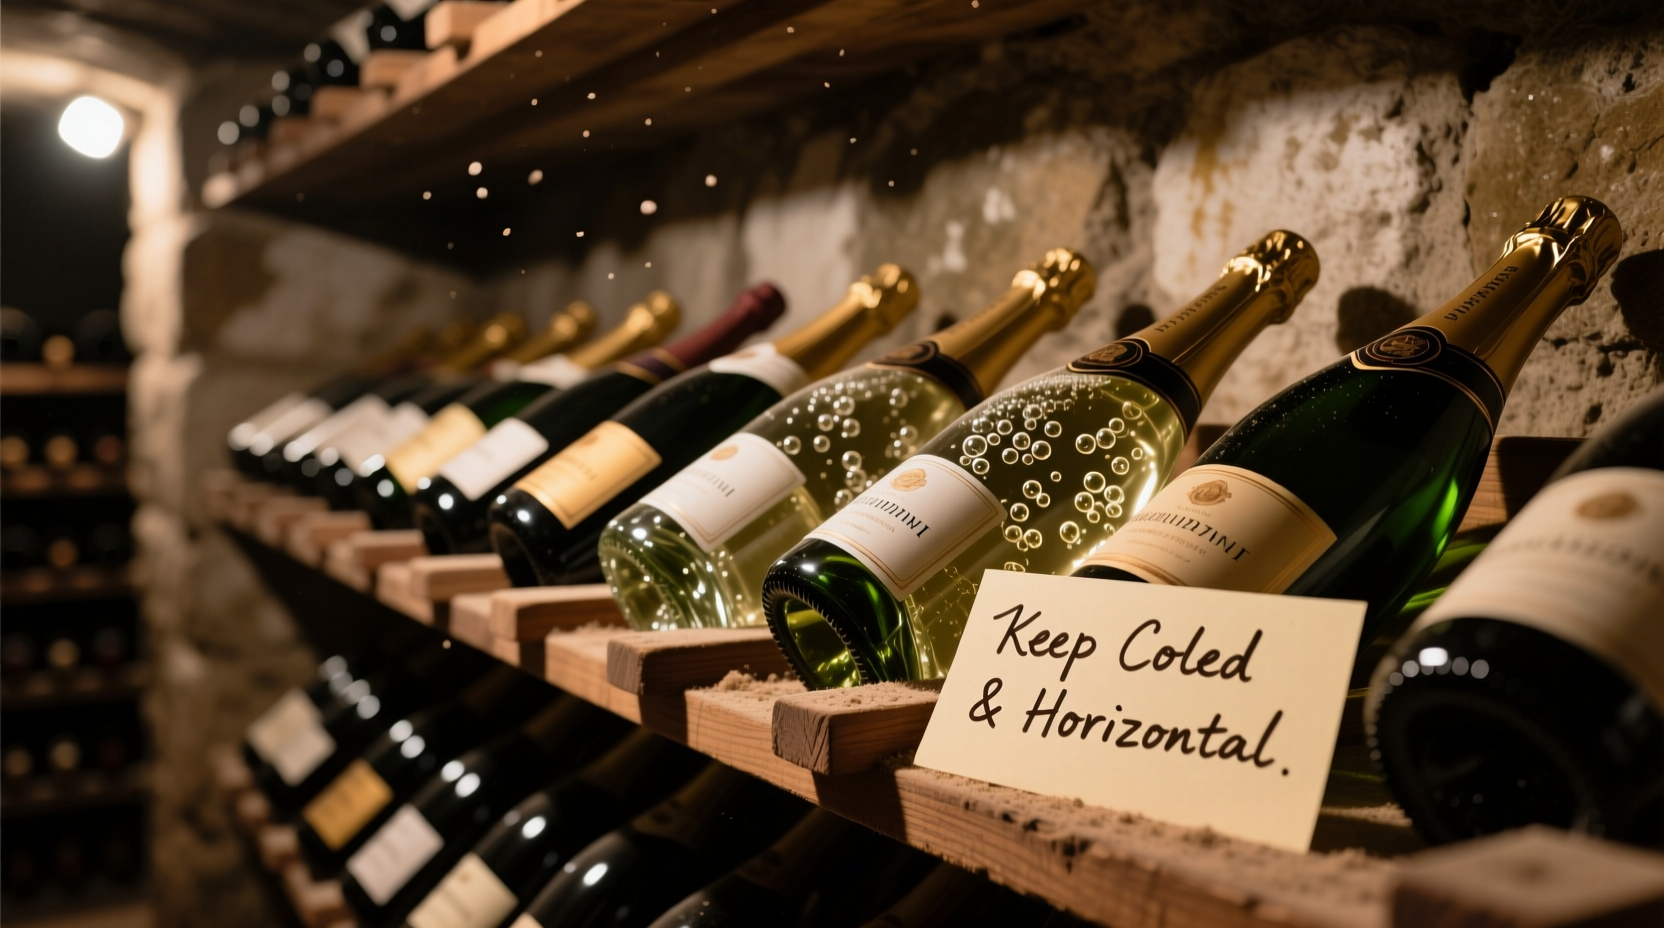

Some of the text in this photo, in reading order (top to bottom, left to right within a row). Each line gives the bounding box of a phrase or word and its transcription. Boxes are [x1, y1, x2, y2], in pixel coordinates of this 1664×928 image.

[993, 604, 1263, 683] Keep Coled
[968, 677, 1290, 776] & Horizontal.
